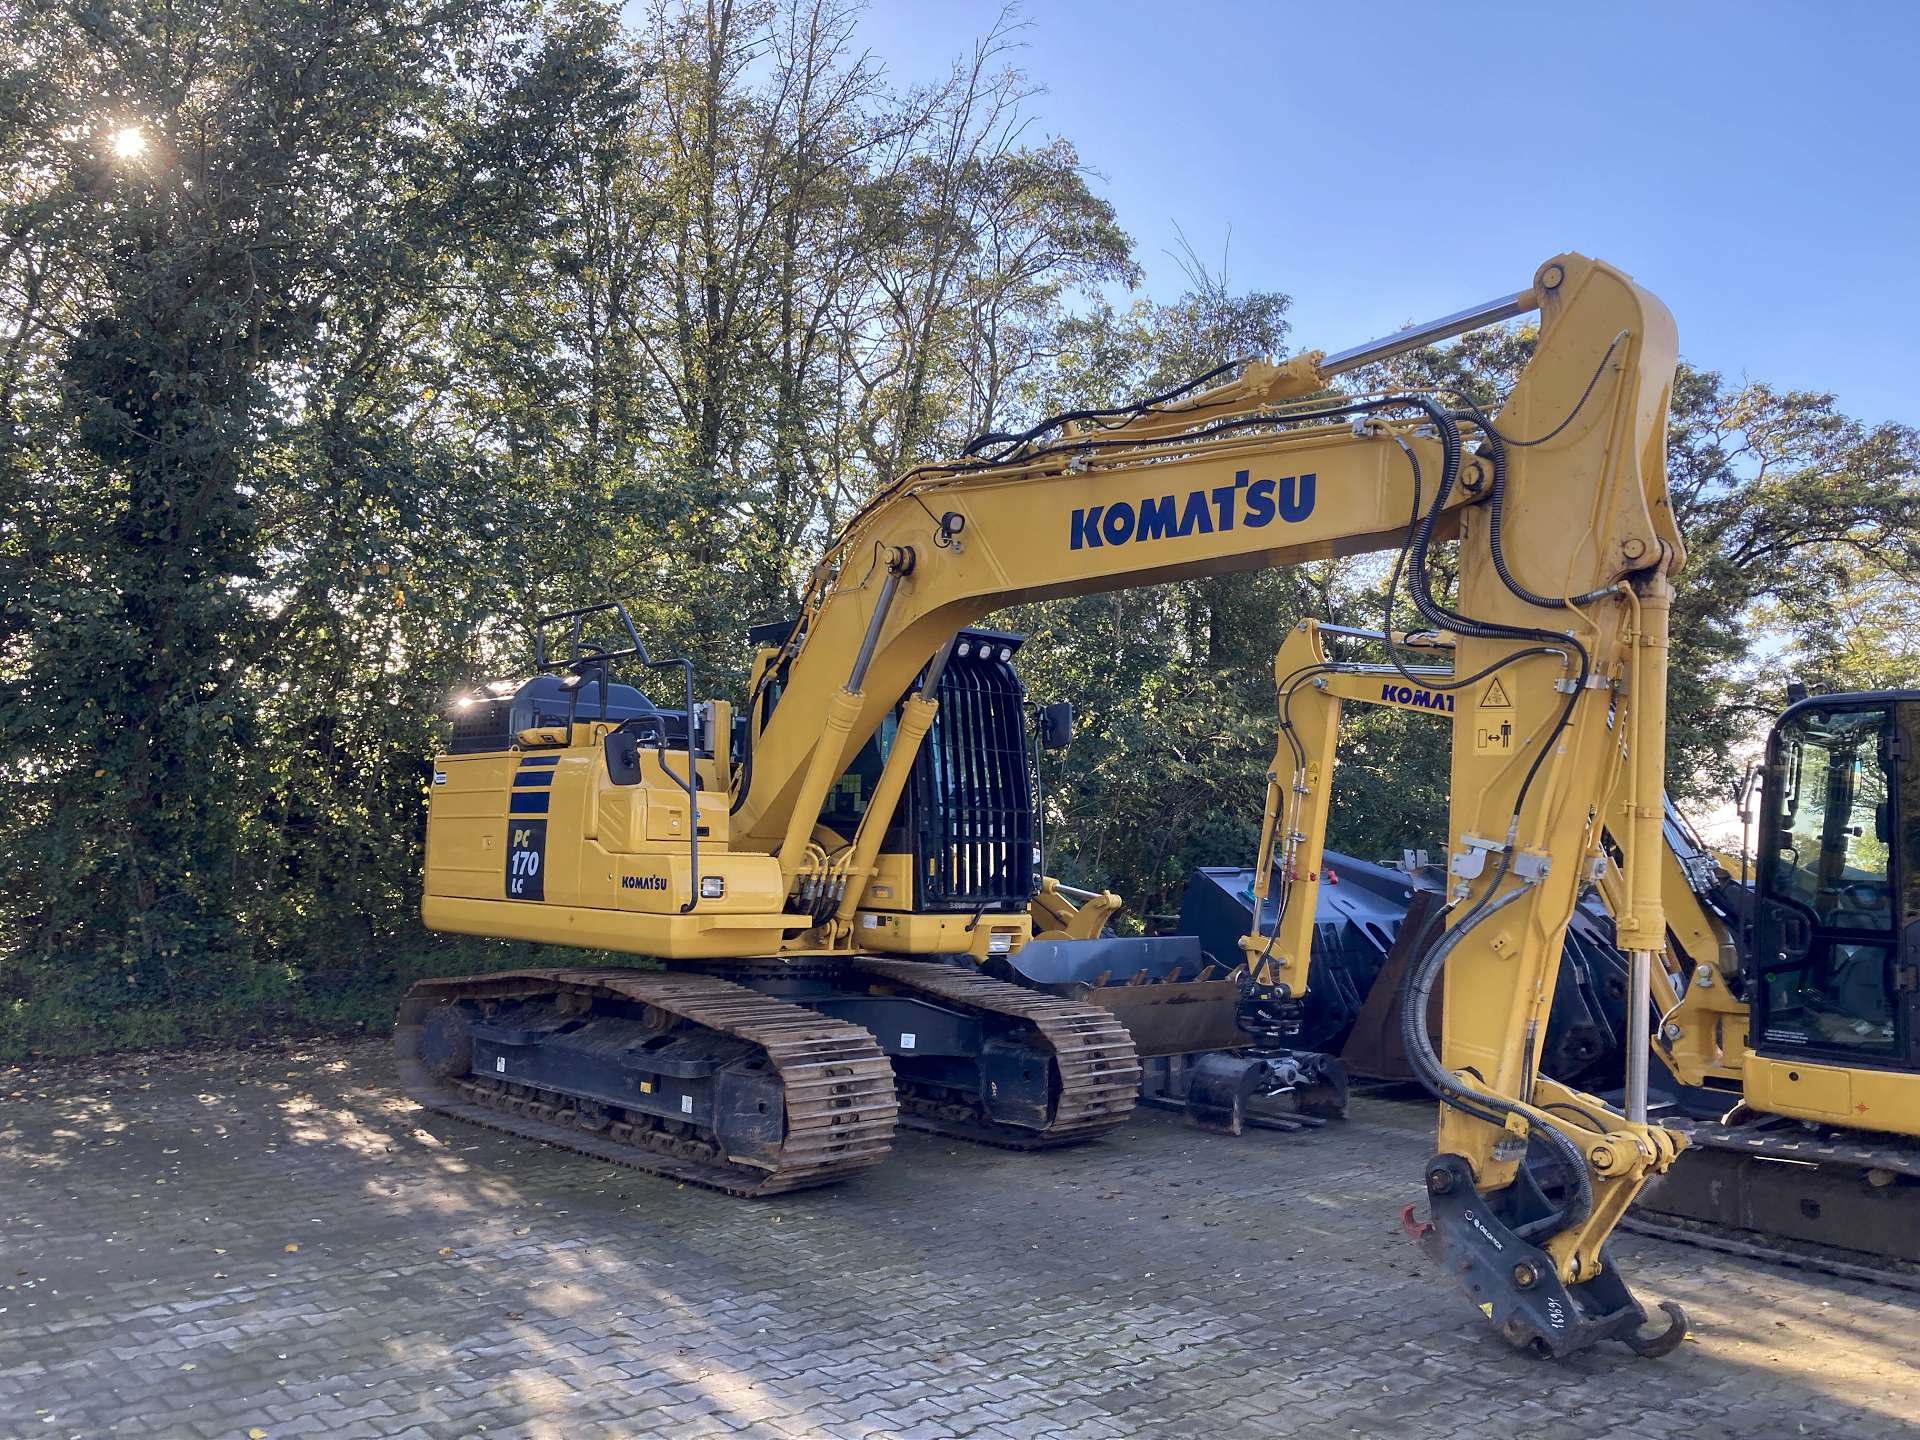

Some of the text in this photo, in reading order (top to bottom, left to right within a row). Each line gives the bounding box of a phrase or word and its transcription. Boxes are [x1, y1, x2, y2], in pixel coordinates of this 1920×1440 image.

[1070, 470, 1316, 550] KOMATSU
[513, 829, 530, 848] PC
[512, 851, 539, 876] 170
[511, 878, 524, 893] LC
[622, 874, 667, 890] KOMATSU
